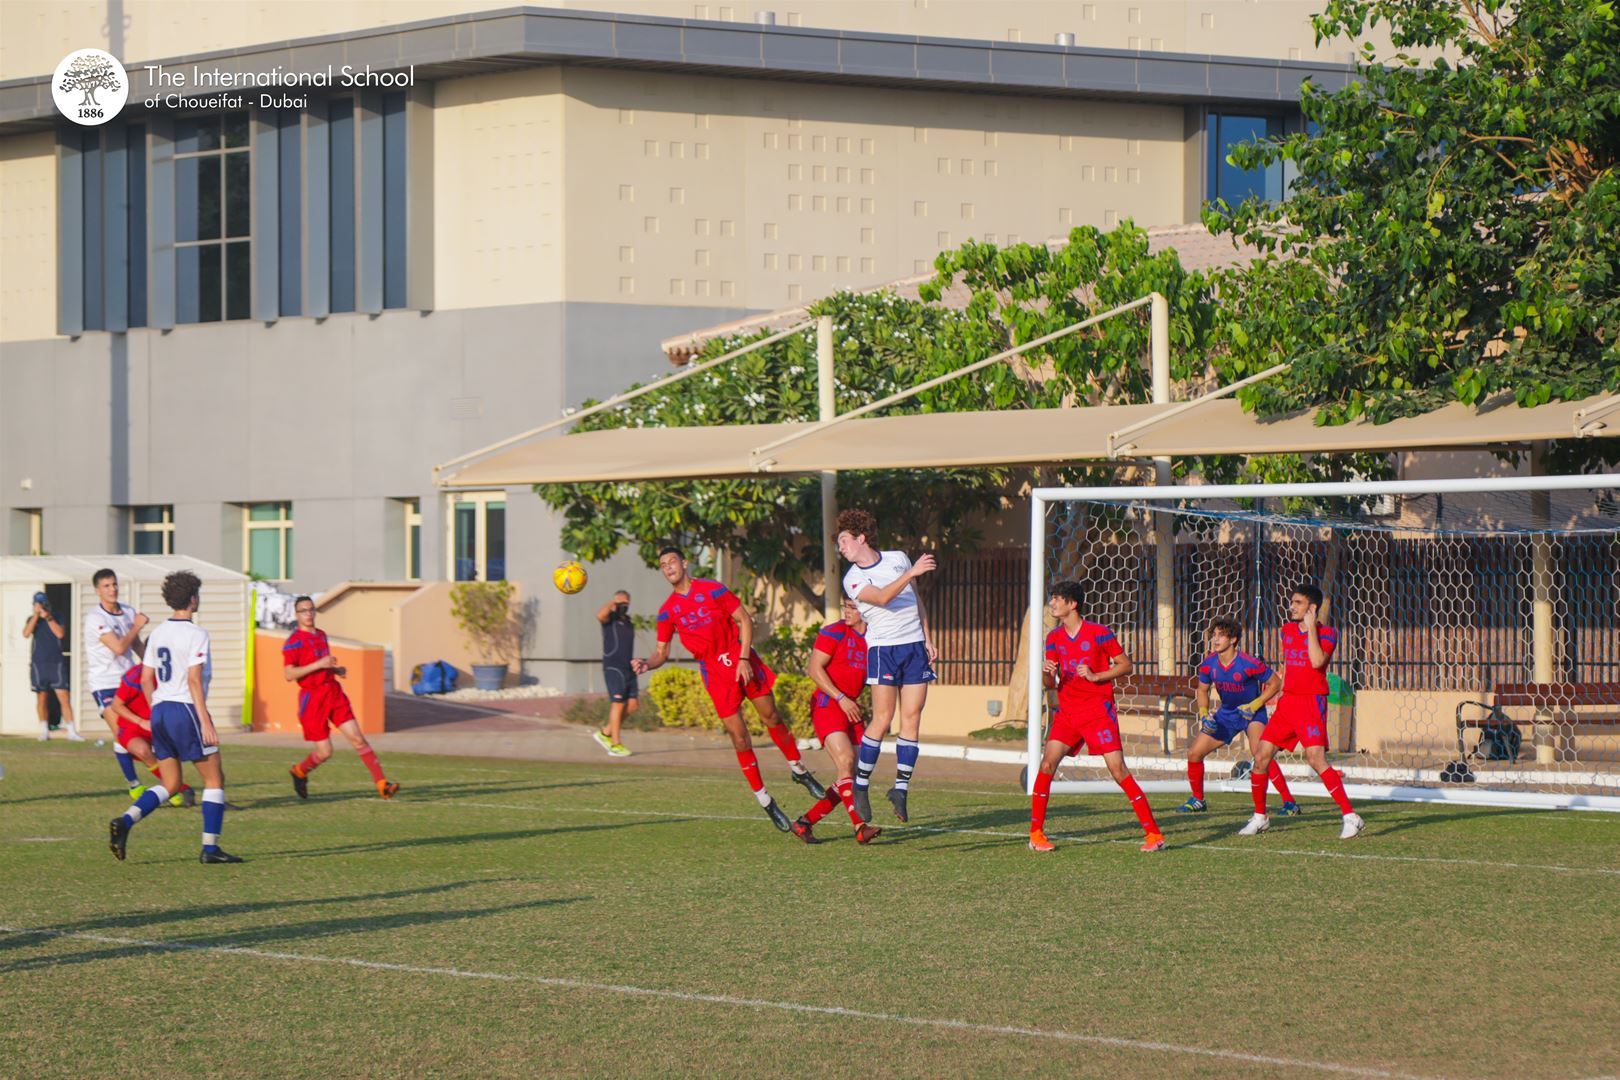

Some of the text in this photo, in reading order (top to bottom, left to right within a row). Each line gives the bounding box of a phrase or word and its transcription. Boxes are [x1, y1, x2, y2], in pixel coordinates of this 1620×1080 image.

[157, 646, 172, 683] 3
[1097, 728, 1113, 745] 13
[1307, 725, 1321, 738] 14
